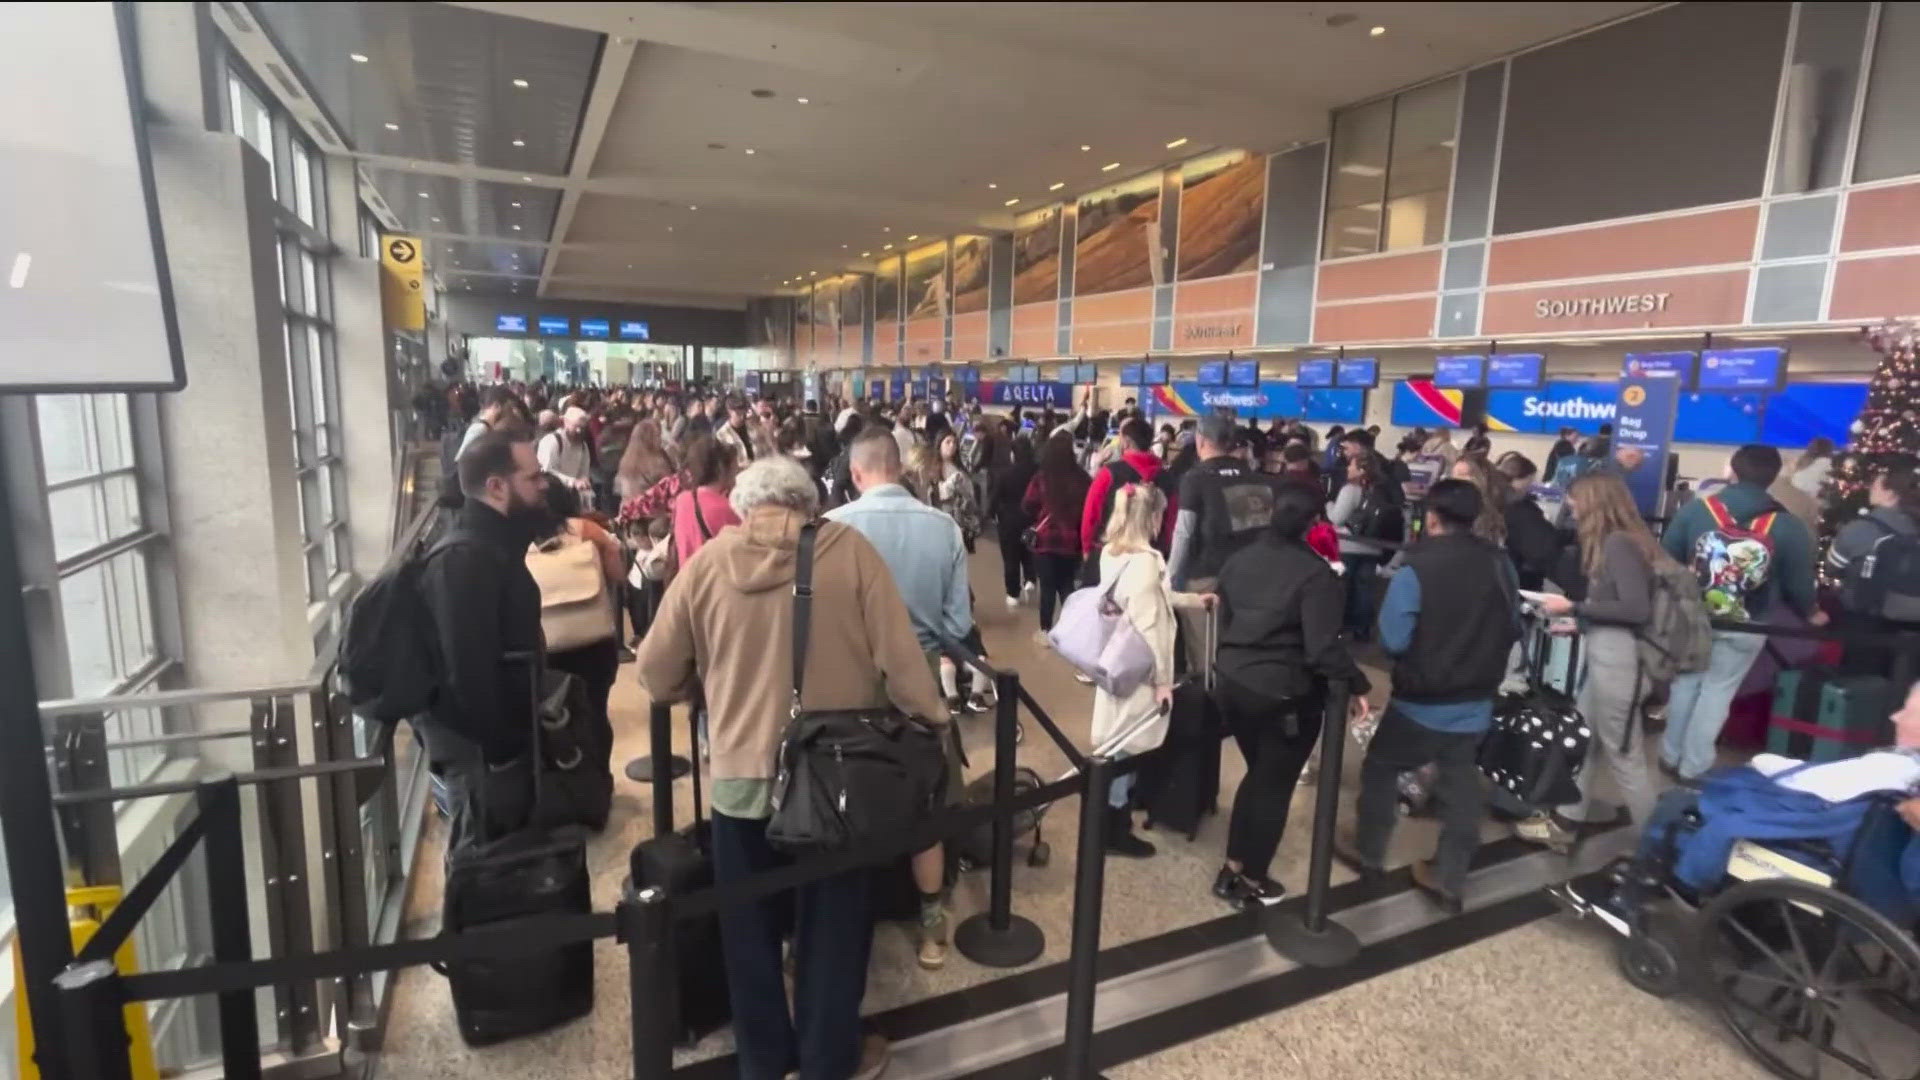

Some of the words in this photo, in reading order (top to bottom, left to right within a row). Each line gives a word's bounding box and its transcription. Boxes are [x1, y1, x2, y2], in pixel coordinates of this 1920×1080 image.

[1535, 293, 1672, 318] SOUTHWEST
[1202, 391, 1254, 407] Southwest
[1523, 396, 1616, 419] Southw
[1620, 416, 1642, 428] Bag
[1619, 428, 1647, 440] Drop
